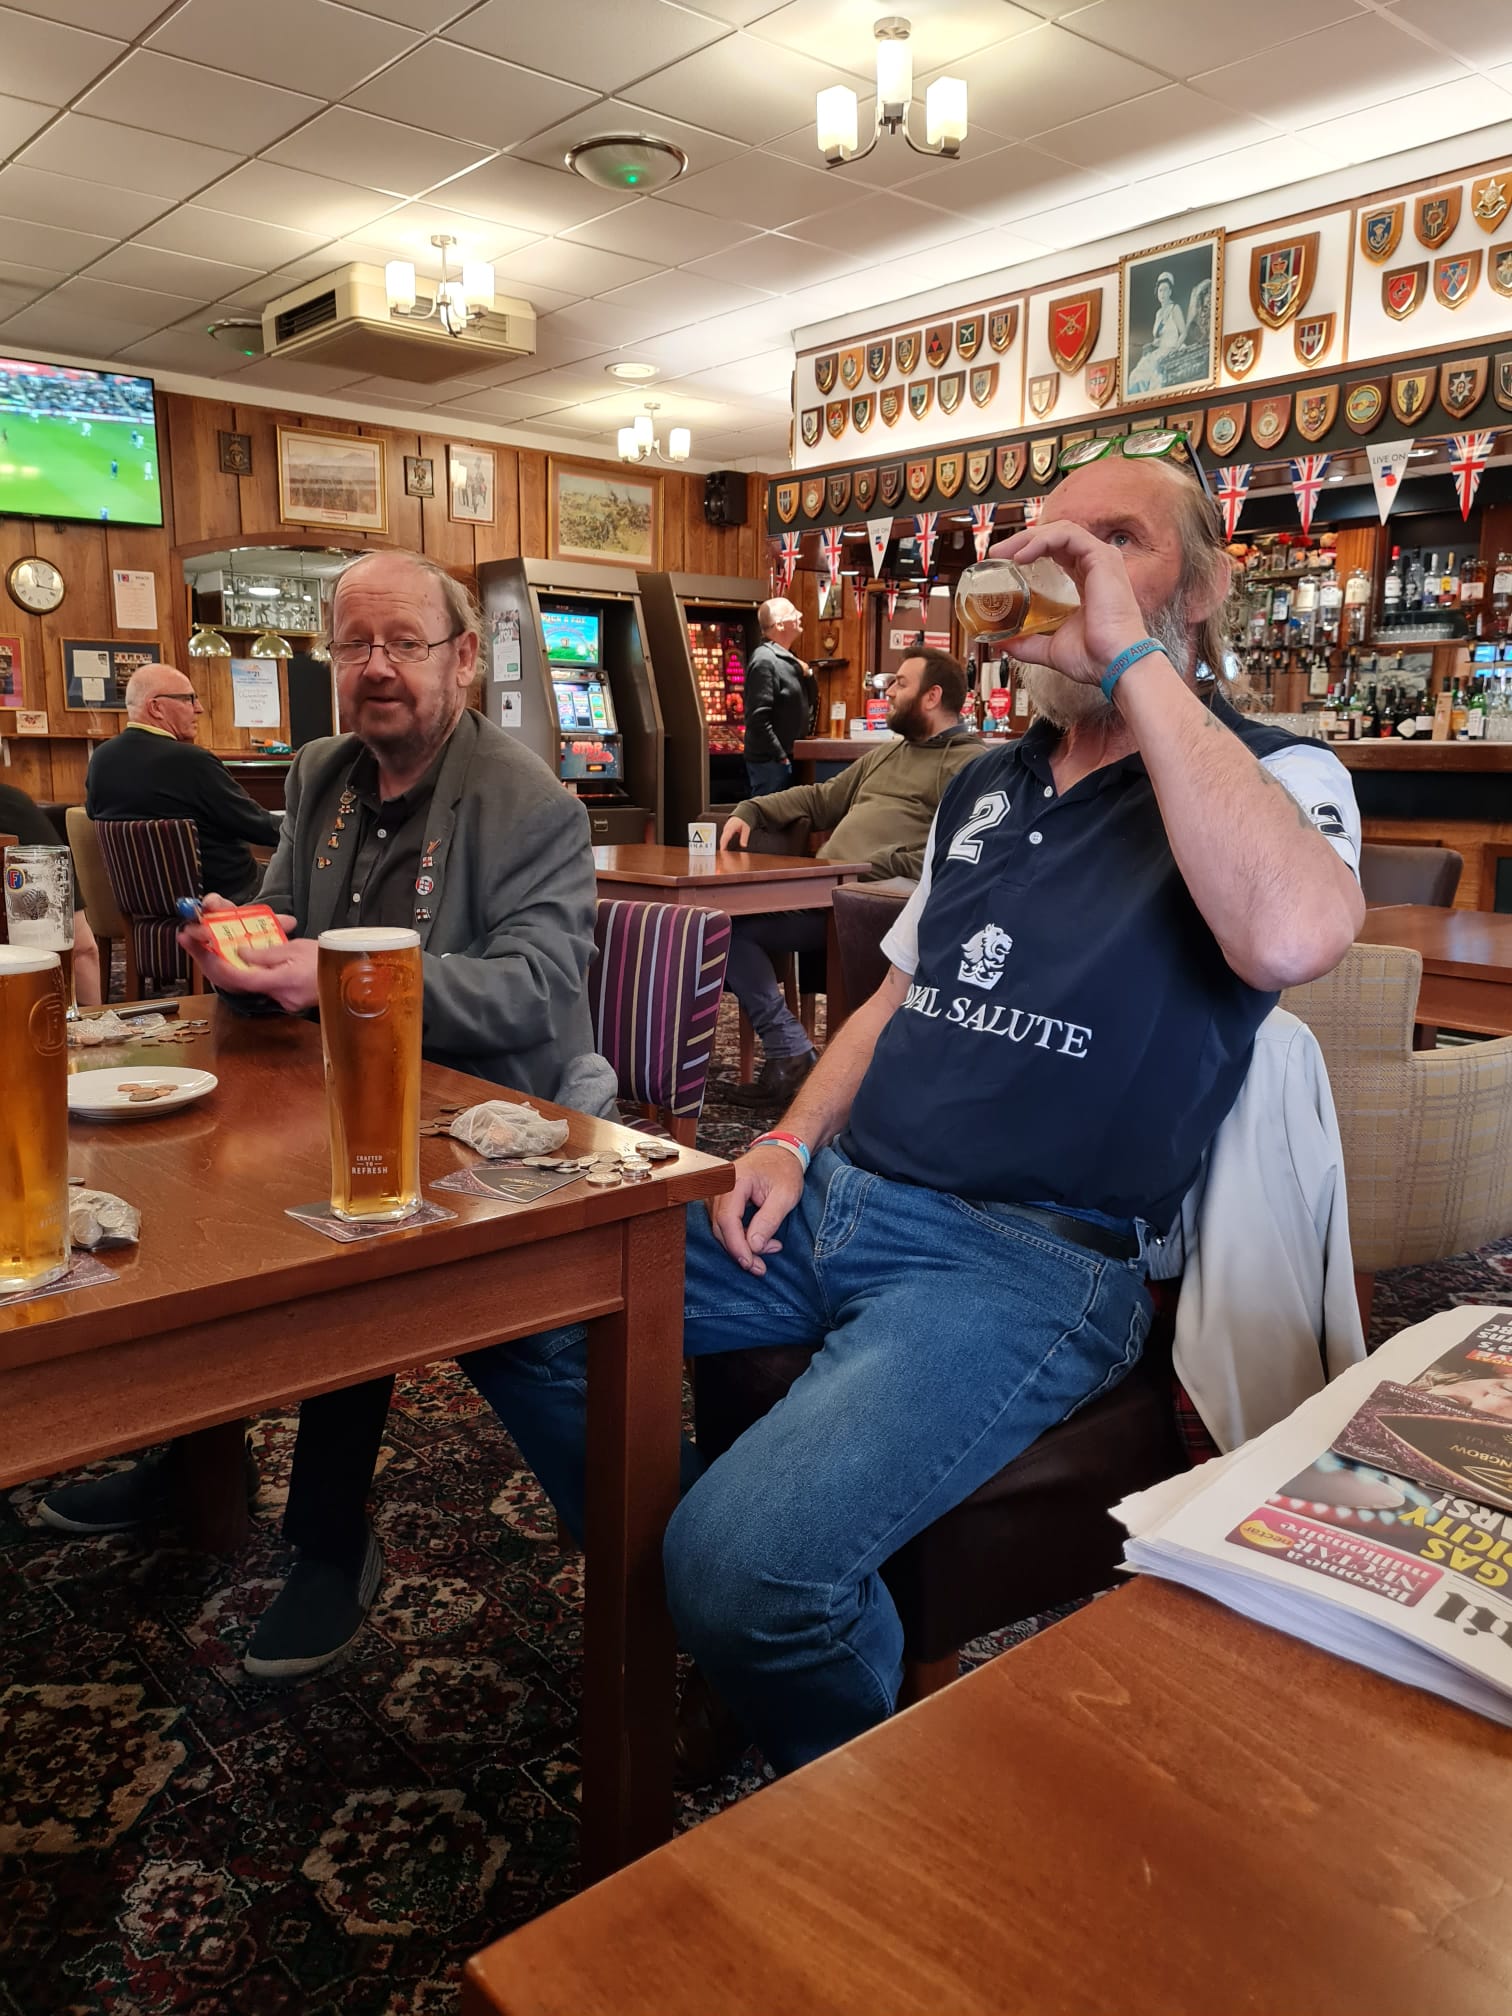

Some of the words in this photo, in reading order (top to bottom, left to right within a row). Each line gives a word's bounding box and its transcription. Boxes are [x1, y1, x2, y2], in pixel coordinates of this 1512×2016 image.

[1373, 455, 1388, 464] LIVE
[1391, 453, 1406, 462] ON
[946, 790, 1011, 865] 2
[9, 870, 18, 888] F
[946, 997, 1093, 1059] SALUTE
[1244, 1525, 1292, 1547] nectar
[1279, 1522, 1432, 1580] millionaire
[1286, 1550, 1303, 1561] a
[1293, 1539, 1422, 1593] NECTAR
[1305, 1557, 1414, 1603] Become
[1419, 1538, 1509, 1587] GAS
